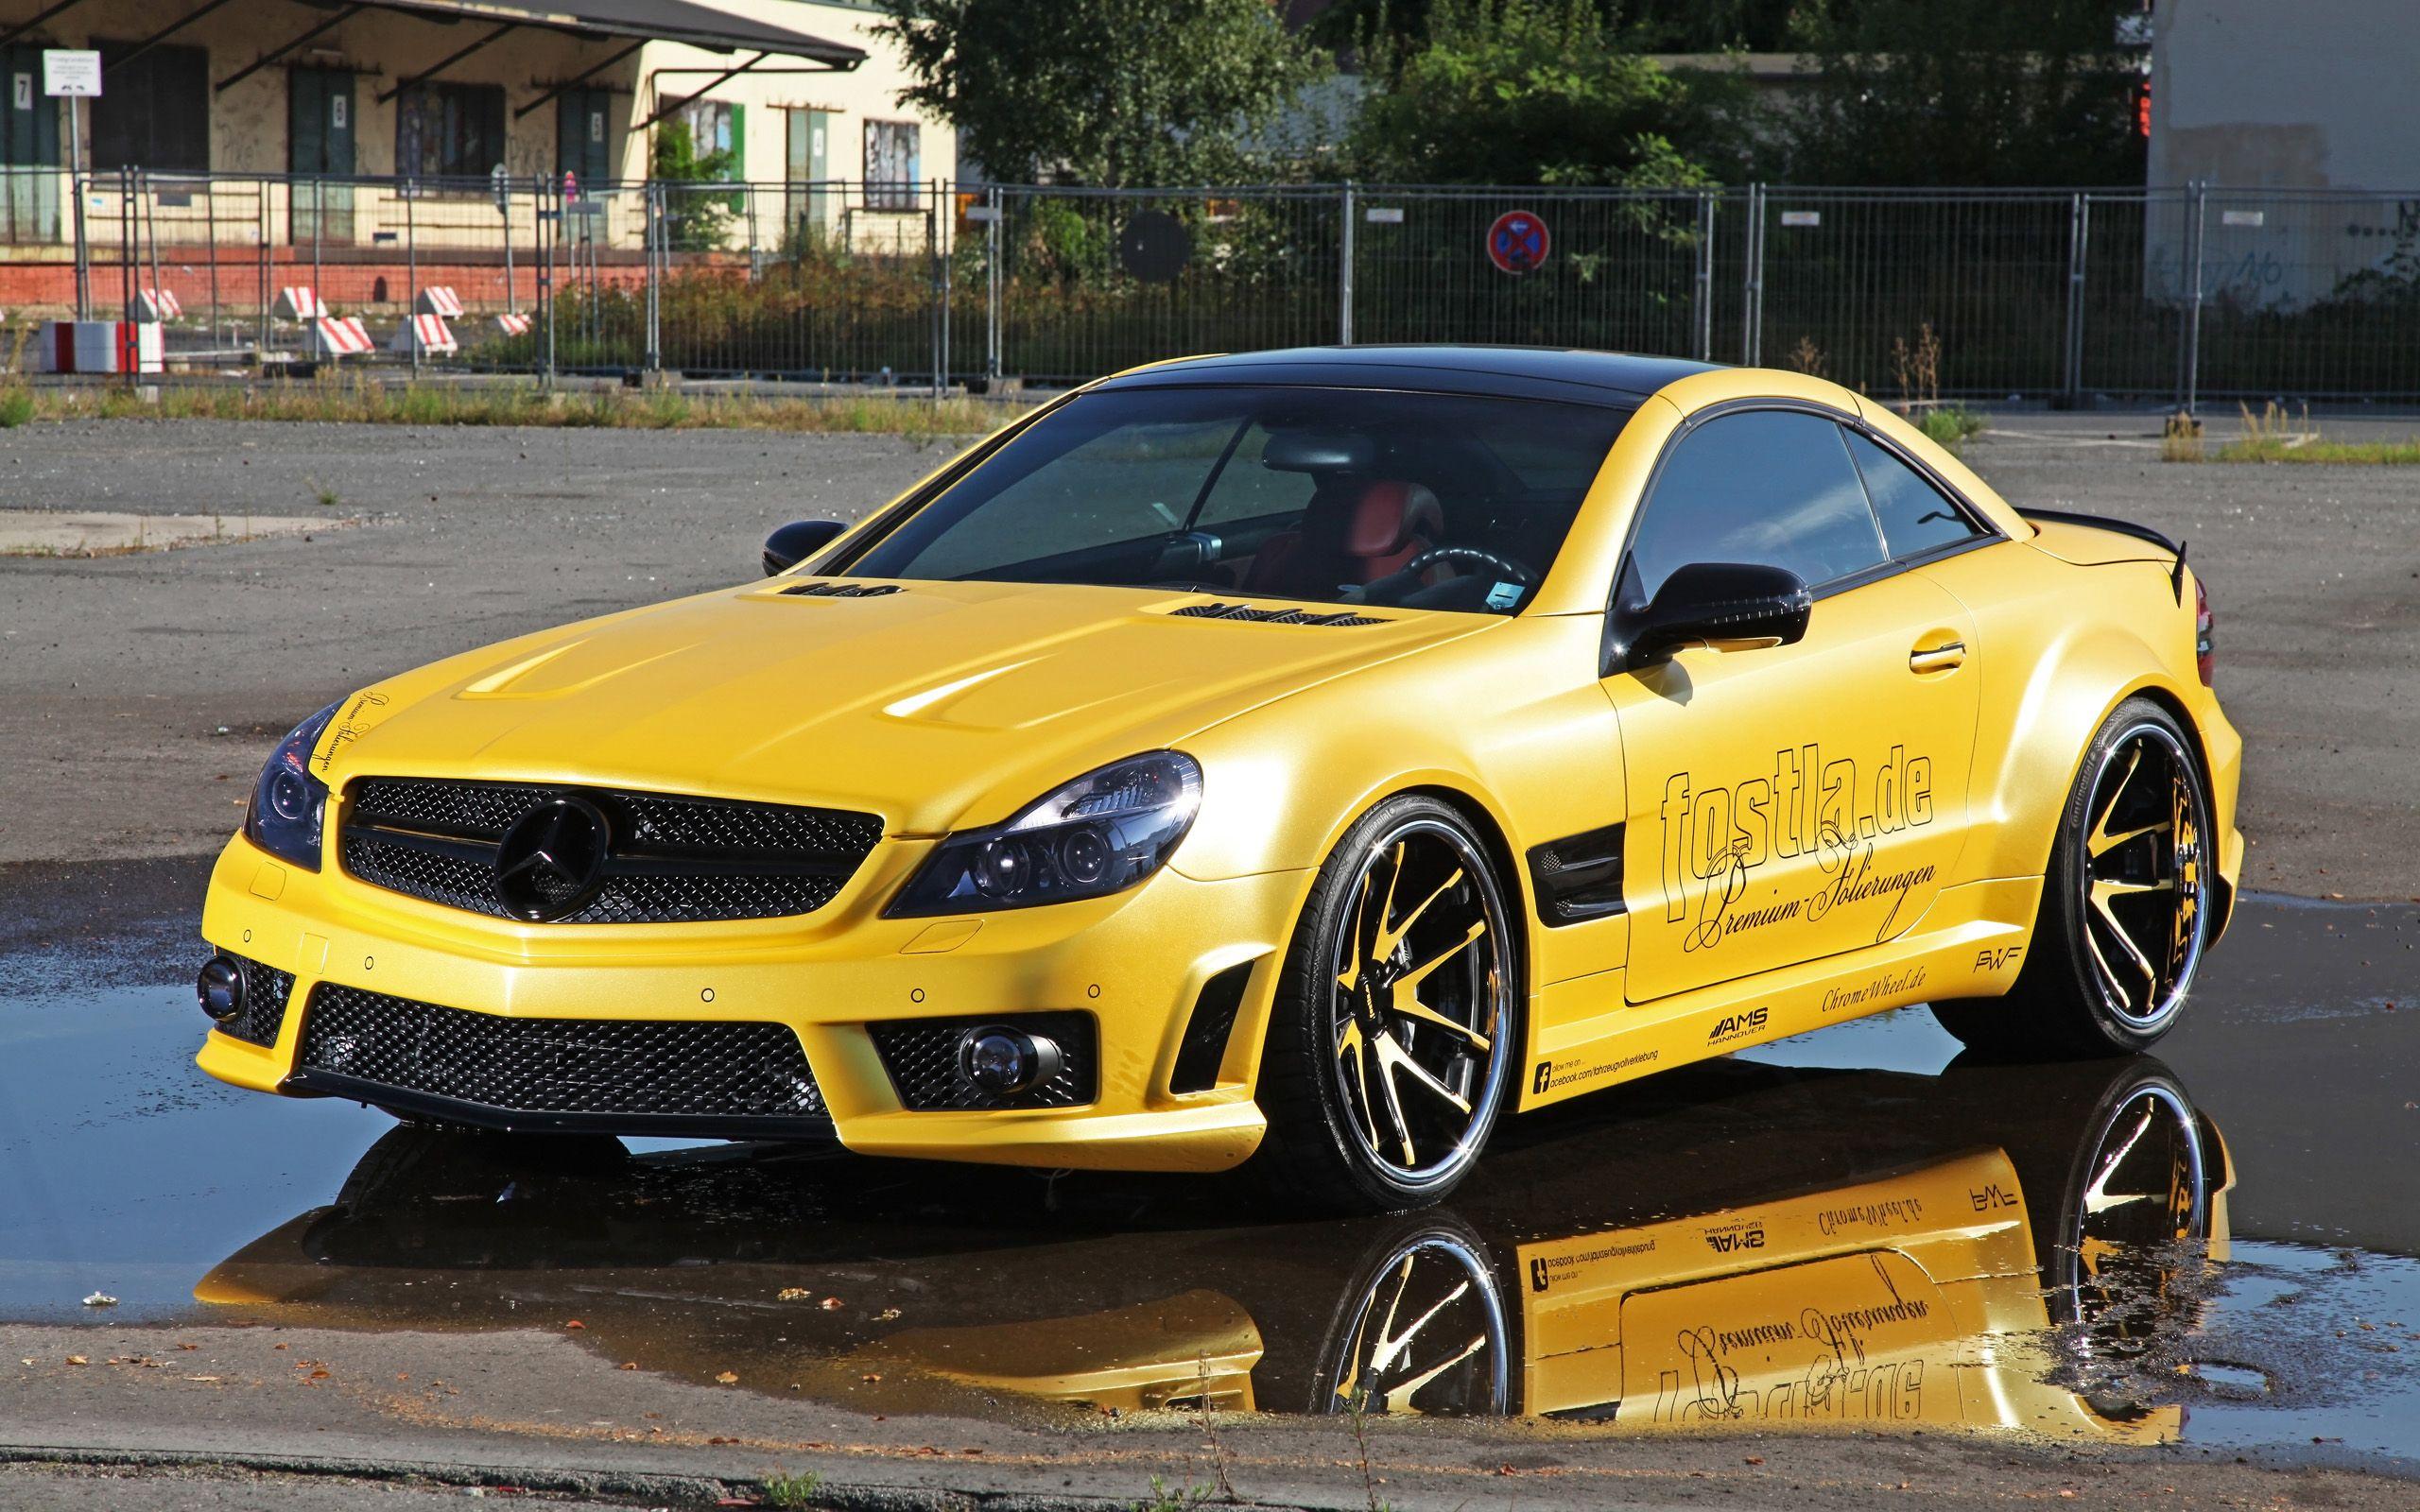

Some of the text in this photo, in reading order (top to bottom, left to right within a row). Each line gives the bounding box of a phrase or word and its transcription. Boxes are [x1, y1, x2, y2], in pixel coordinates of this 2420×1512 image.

[19, 79, 27, 102] 7
[1661, 744, 1933, 923] fostla.de
[1822, 966, 1927, 1013] ChromeWheel.de
